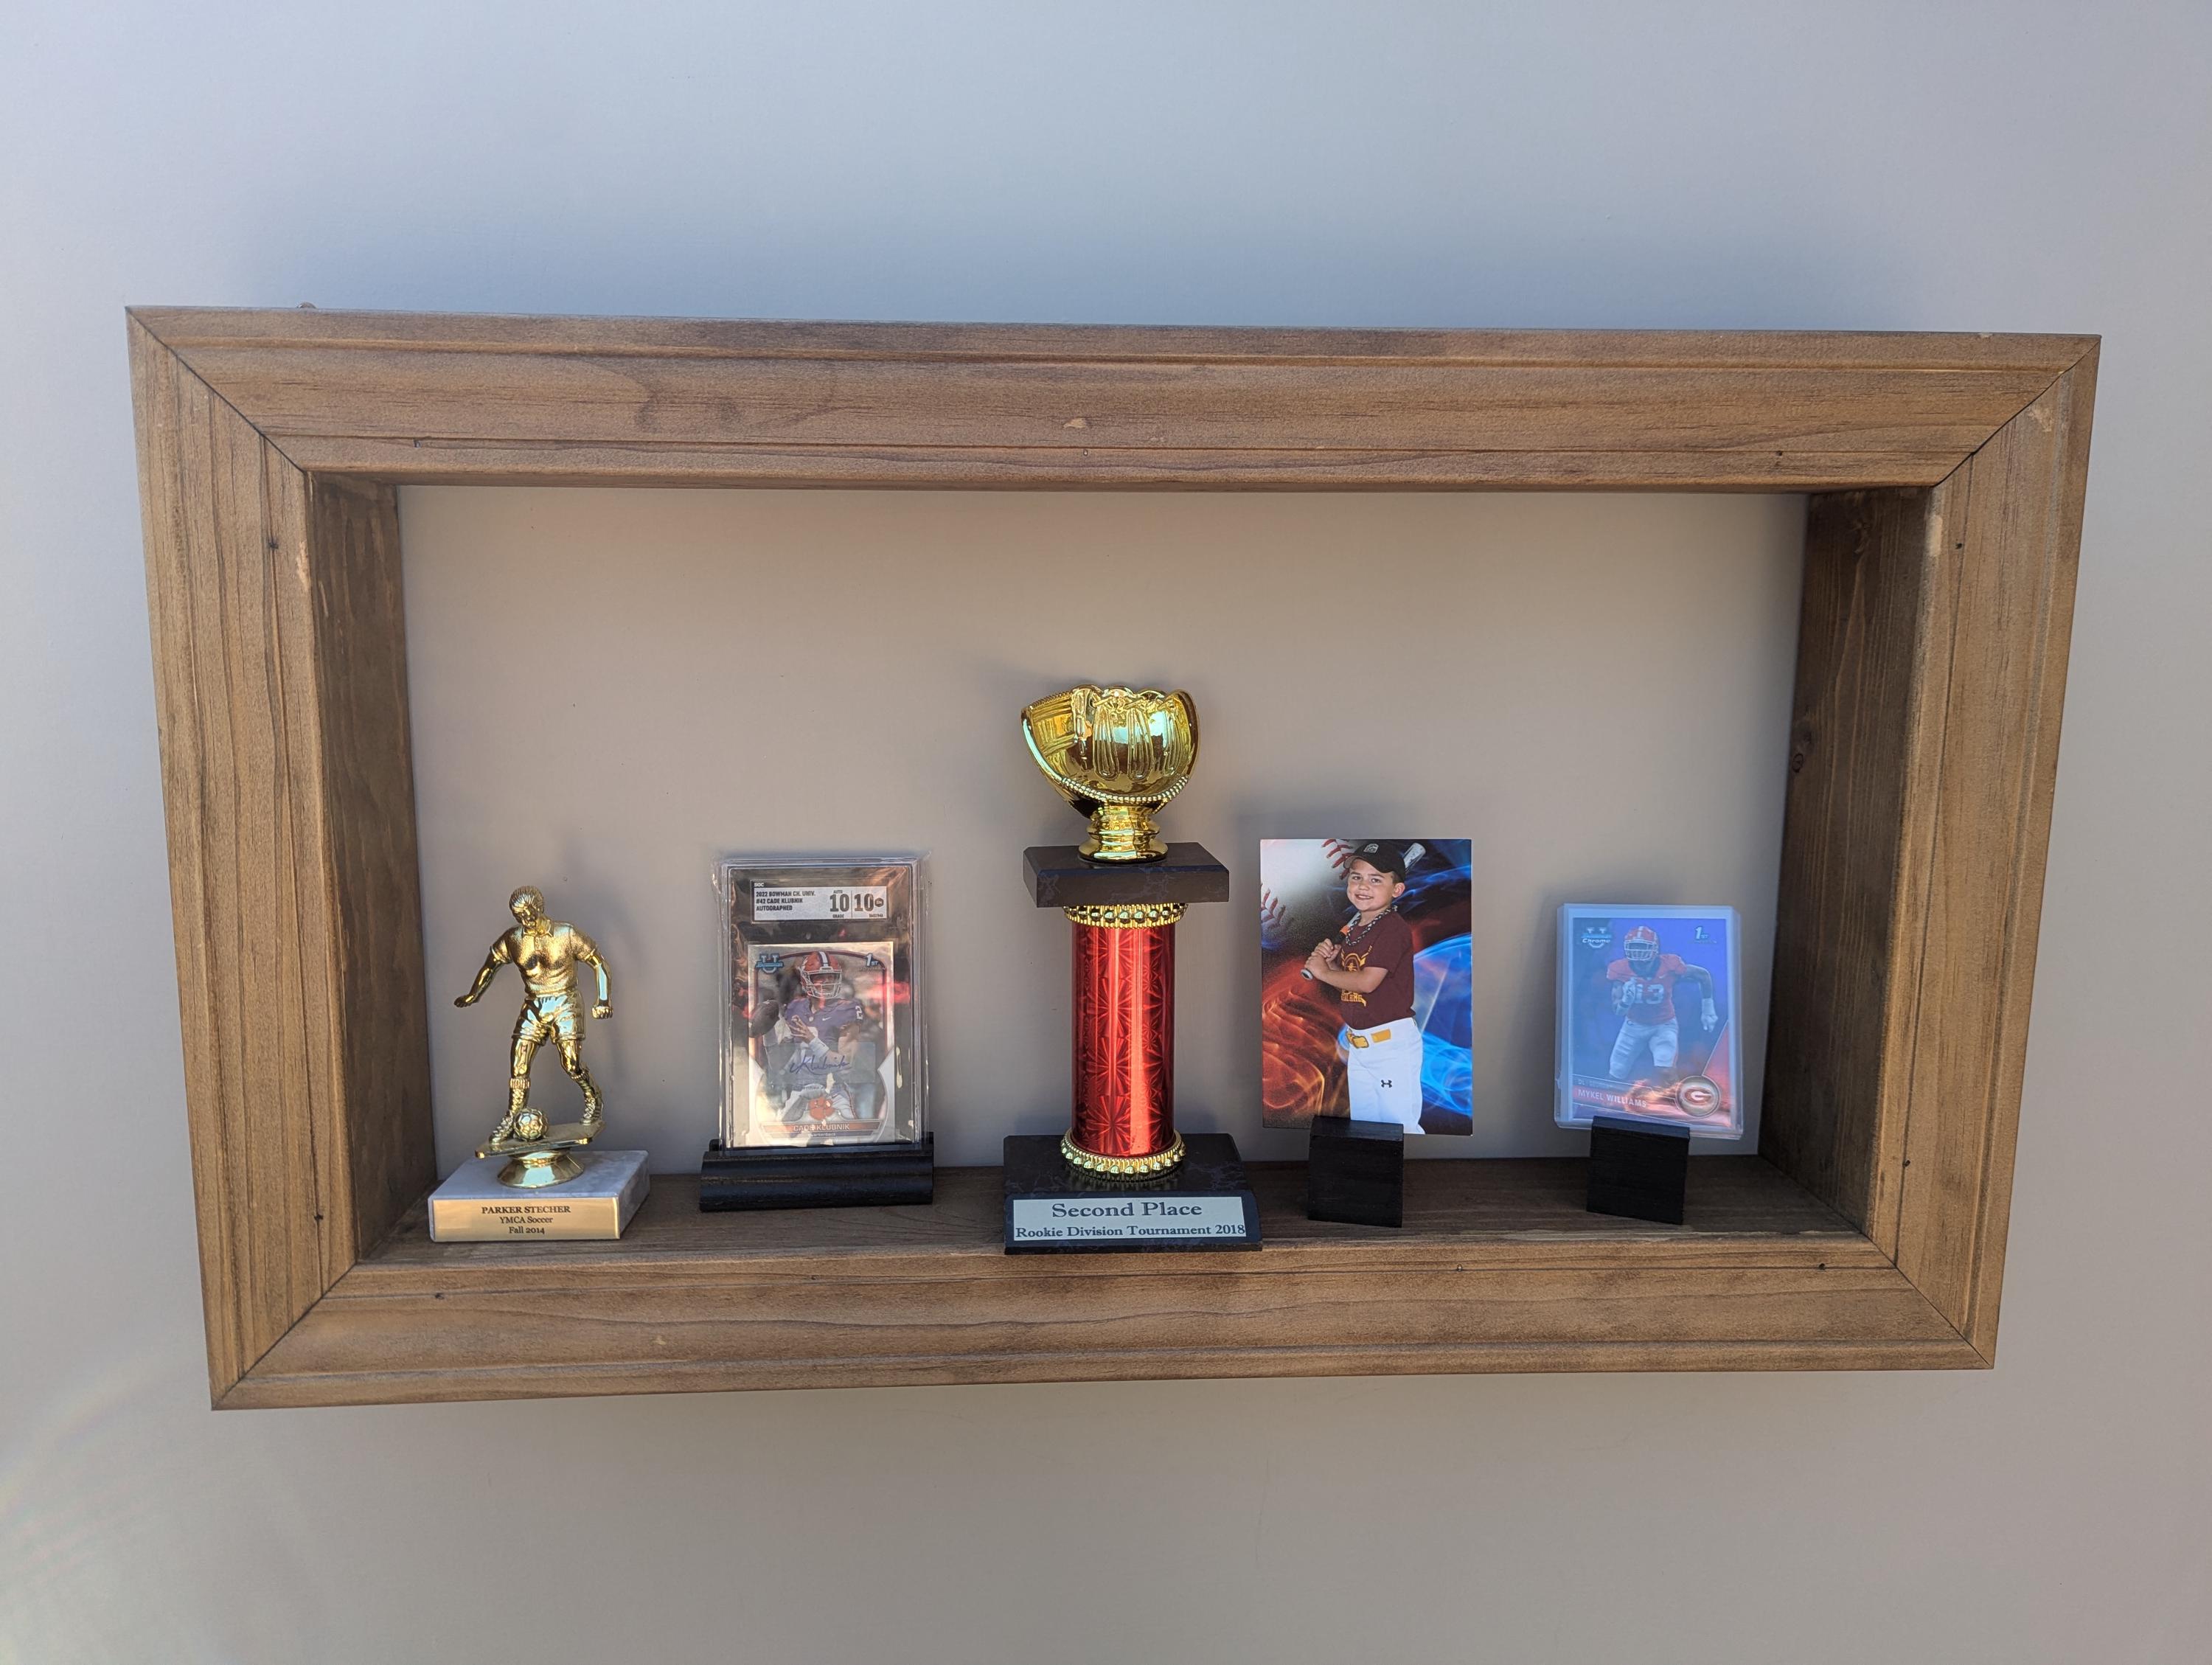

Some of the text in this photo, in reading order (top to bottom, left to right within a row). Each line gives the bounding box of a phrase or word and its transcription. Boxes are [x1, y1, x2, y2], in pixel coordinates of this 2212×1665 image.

[830, 894, 849, 912] 10
[854, 893, 874, 911] 10
[1578, 1088, 1647, 1108] MYKEL WILLIAMS
[816, 1123, 850, 1131] KLUBNIK
[481, 1205, 571, 1214] PARKER STECHER
[1051, 1201, 1203, 1217] Second Place
[499, 1215, 554, 1224] YMCA Soccer
[1015, 1224, 1246, 1238] Rookie Division Tournament 2018
